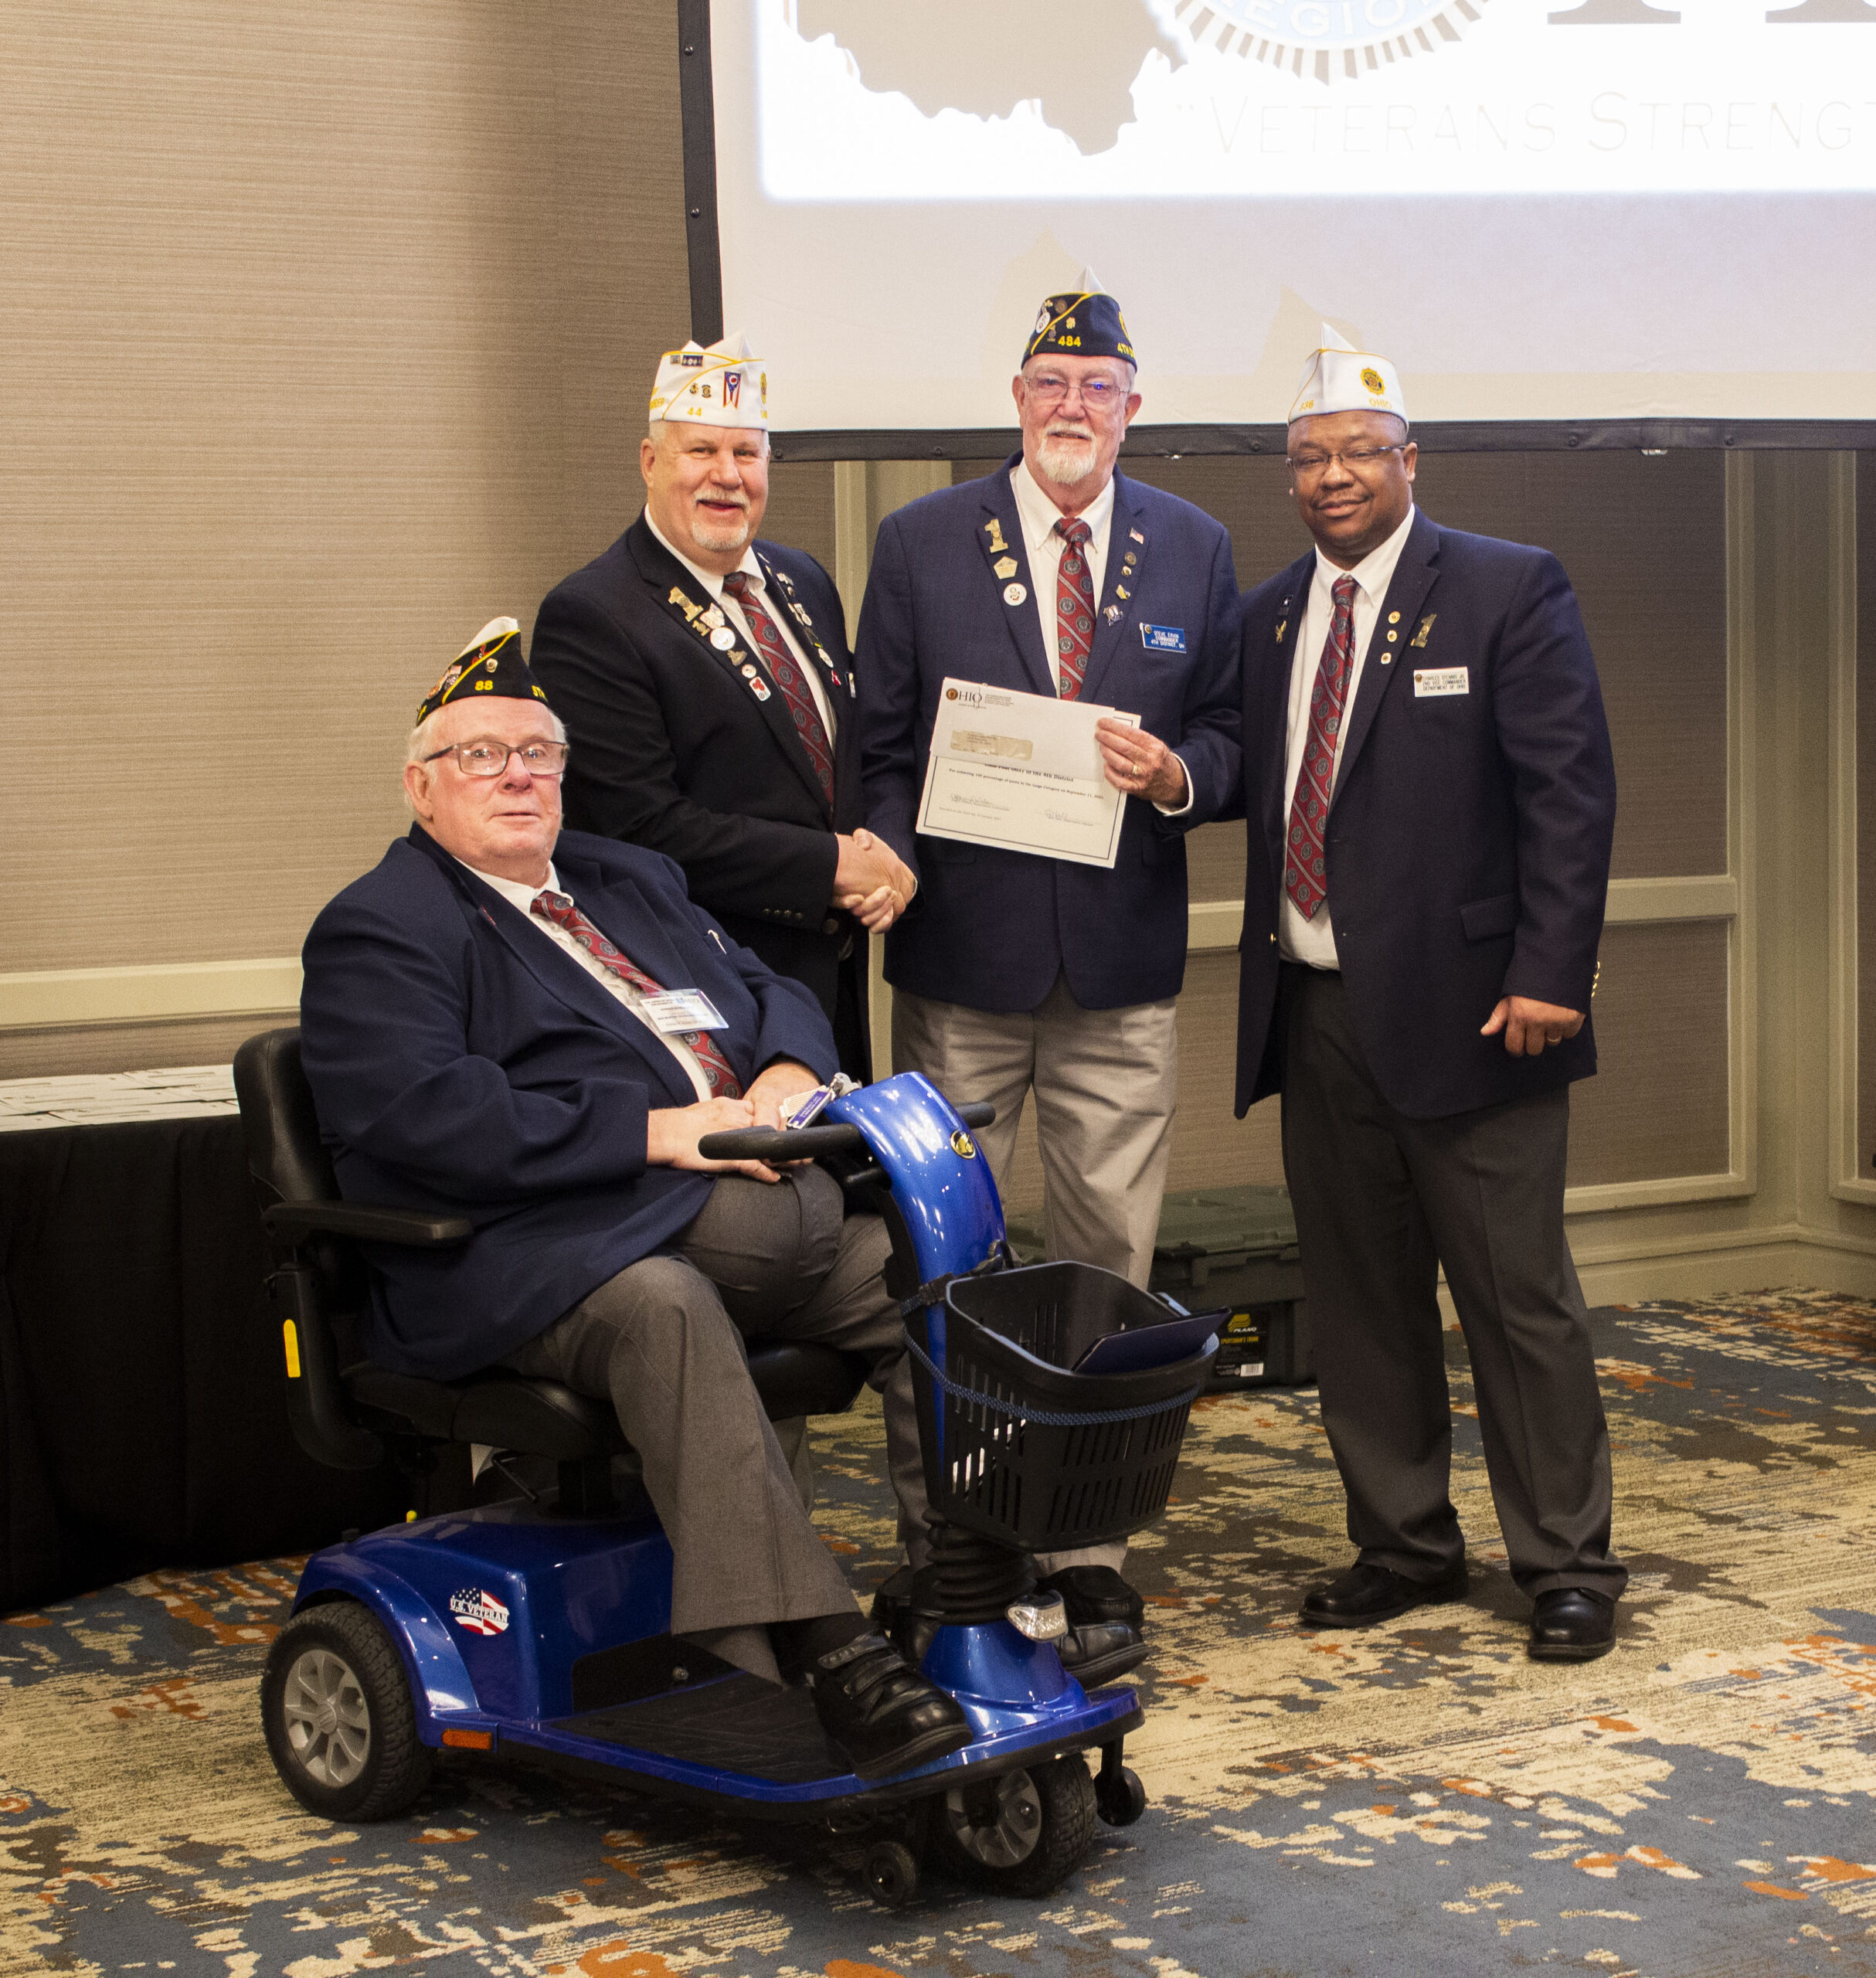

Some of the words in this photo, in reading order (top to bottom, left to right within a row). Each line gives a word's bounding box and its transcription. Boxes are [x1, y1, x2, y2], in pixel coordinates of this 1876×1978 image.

[1223, 0, 1429, 36] EGIO
[1588, 90, 1876, 153] STRENG
[1058, 335, 1081, 347] 484
[687, 406, 702, 417] 44
[474, 680, 494, 692] 88
[1054, 773, 1074, 782] District
[450, 1599, 466, 1613] U.S.
[467, 1603, 508, 1623] VETERAN
